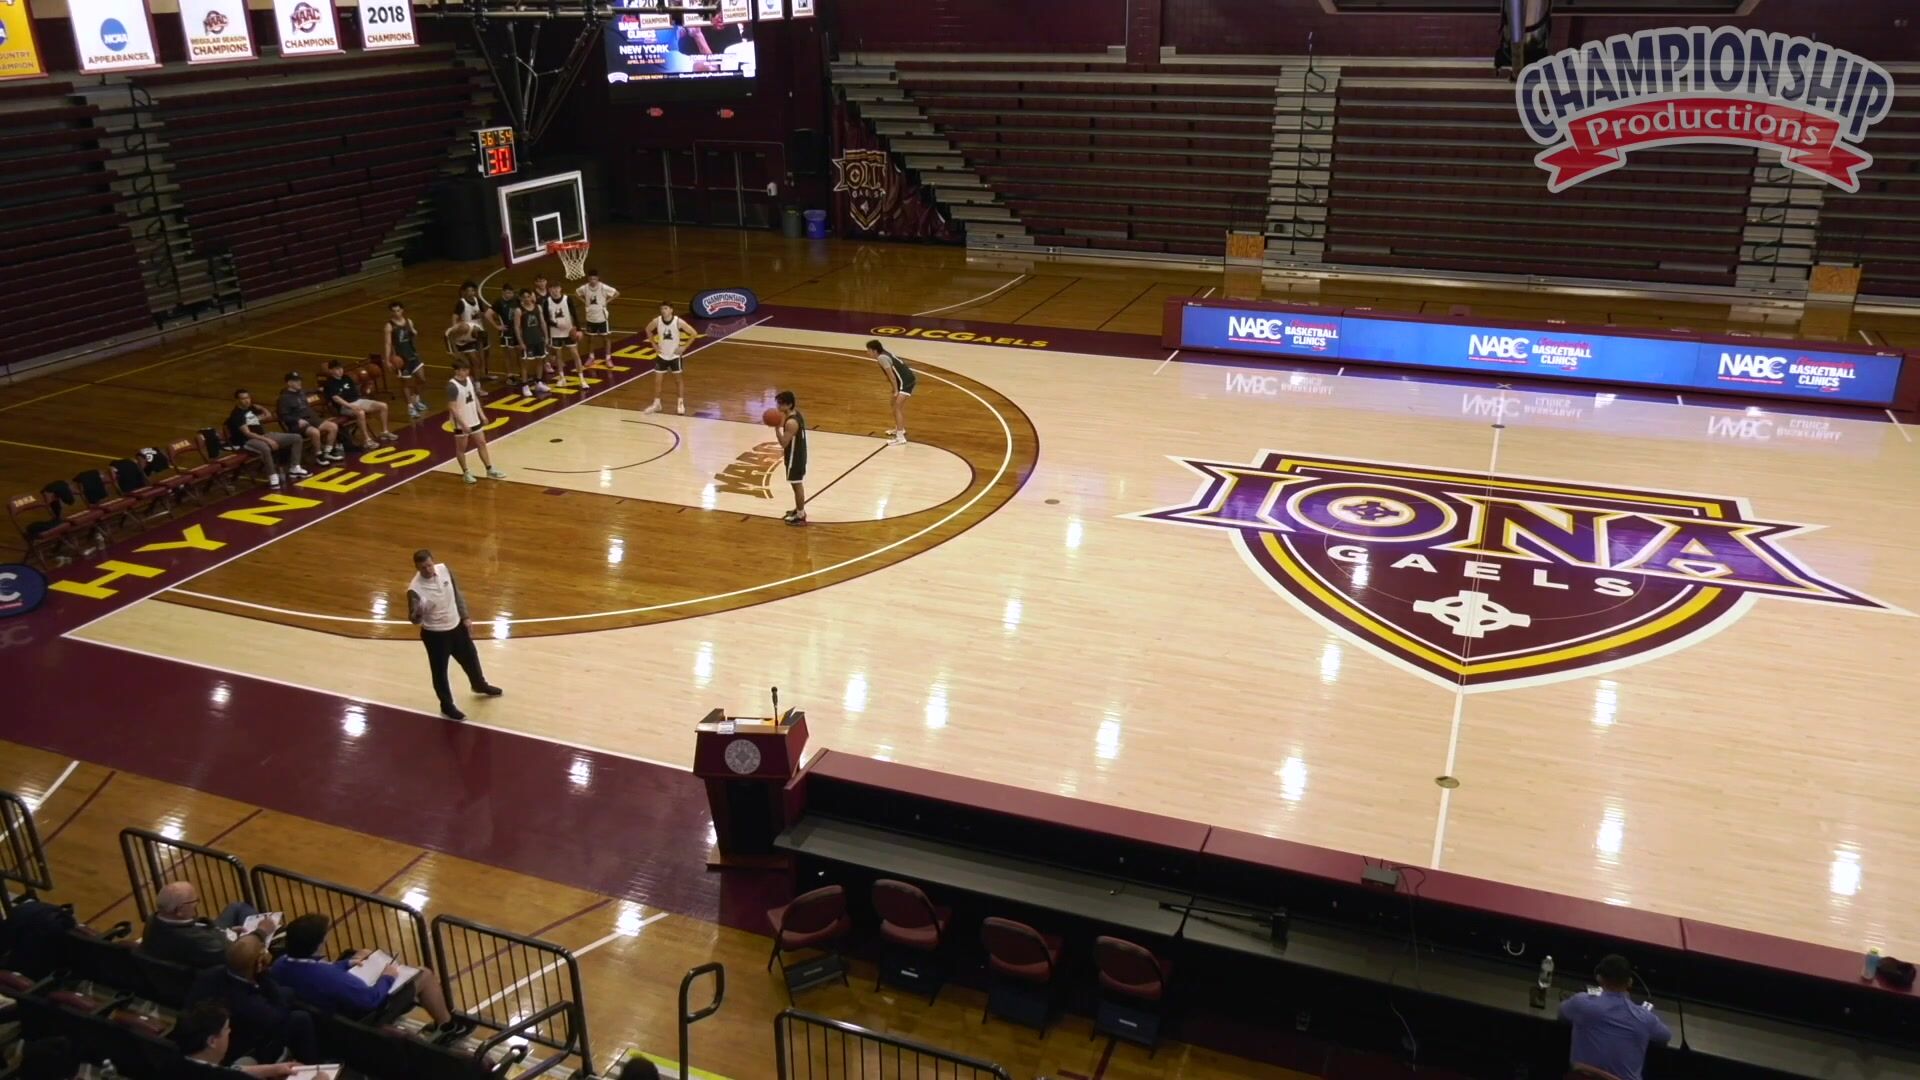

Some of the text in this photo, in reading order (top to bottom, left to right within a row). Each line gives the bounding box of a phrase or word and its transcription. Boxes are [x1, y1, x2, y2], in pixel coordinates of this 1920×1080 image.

[203, 13, 230, 30] MAAC
[291, 8, 321, 27] MAAC
[367, 6, 405, 24] 2018
[104, 33, 129, 45] NCAA
[285, 37, 336, 49] CHAMPIONS
[367, 32, 413, 44] CHAMPIONS
[192, 44, 249, 56] CHAMPIONS
[619, 44, 670, 55] NEW YORK
[88, 52, 150, 65] APPEARANCES
[488, 148, 510, 174] 30
[1228, 316, 1283, 340] NABC
[1285, 325, 1339, 339] BASKETBALL
[1293, 335, 1326, 347] CLINICS
[1468, 334, 1530, 359] NABC
[1532, 344, 1592, 358] BASKETBALL
[1541, 355, 1578, 366] CLINICS
[1718, 352, 1787, 379] NABC
[1789, 364, 1857, 379] BASKETBALL
[1798, 375, 1840, 387] CLINICS
[48, 446, 432, 600] HYNES
[1122, 454, 1908, 613] IONA
[1326, 544, 1635, 598] GAELS
